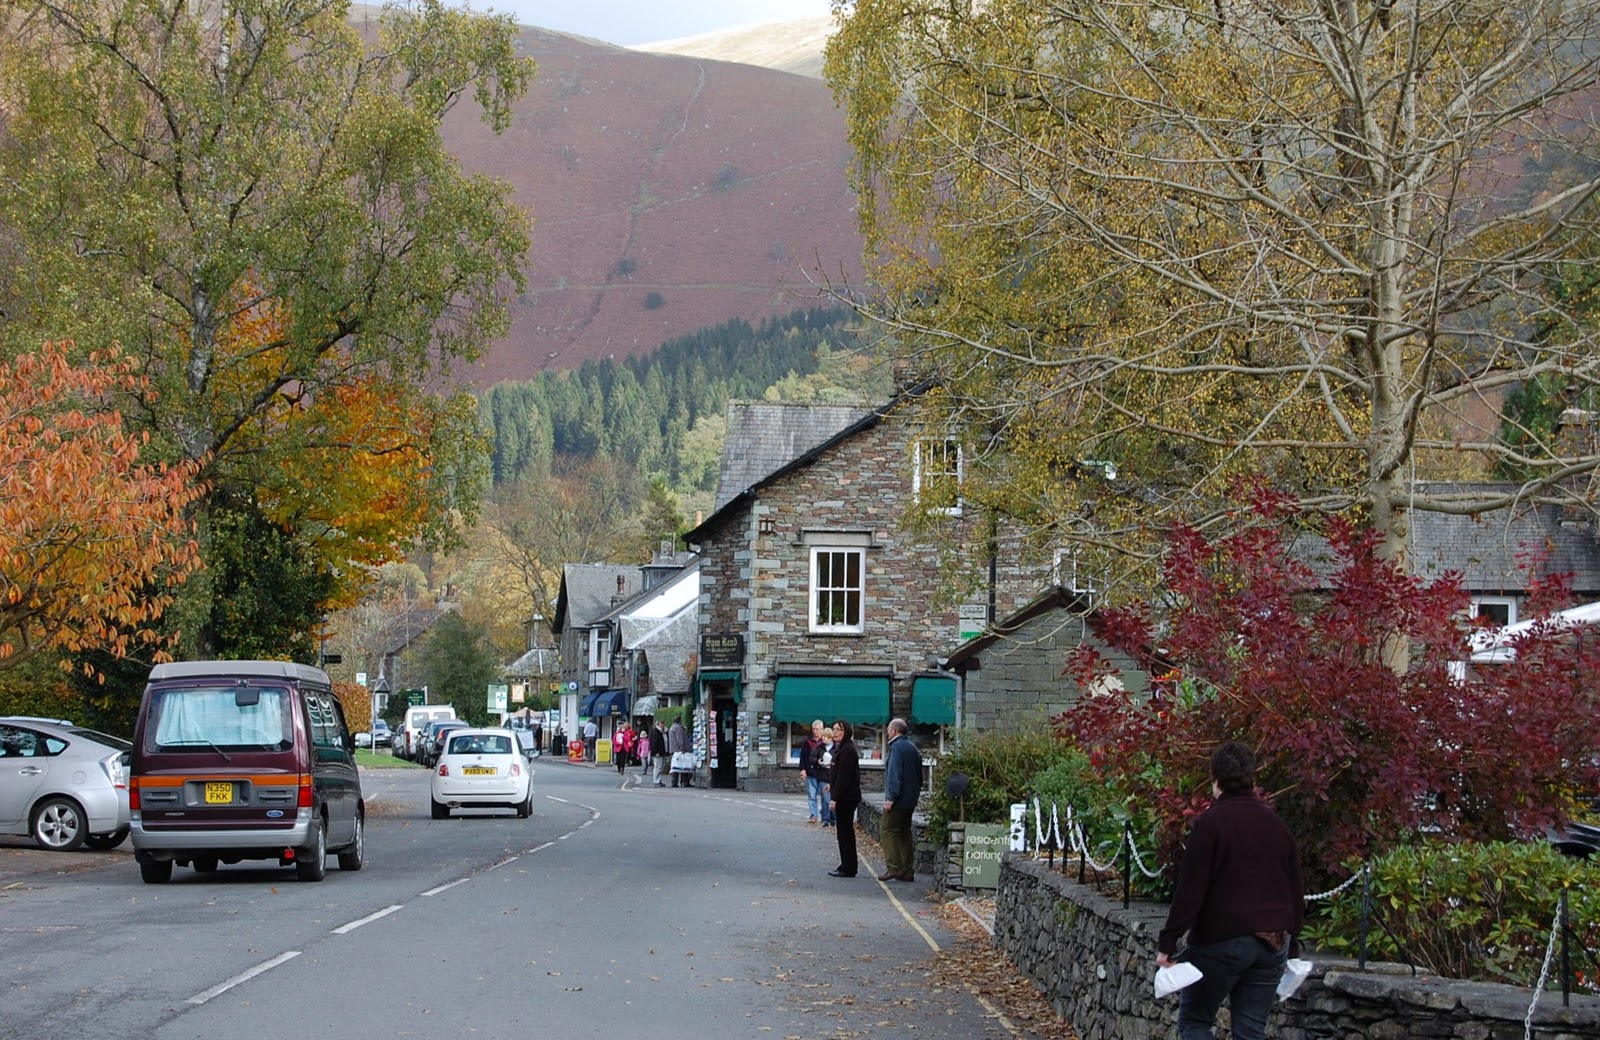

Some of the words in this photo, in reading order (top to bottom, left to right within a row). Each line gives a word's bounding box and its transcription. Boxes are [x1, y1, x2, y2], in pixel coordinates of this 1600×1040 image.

[705, 636, 720, 647] Sam
[721, 636, 738, 647] Read
[207, 783, 231, 792] N350
[210, 792, 228, 801] FKK
[965, 850, 1004, 864] parking
